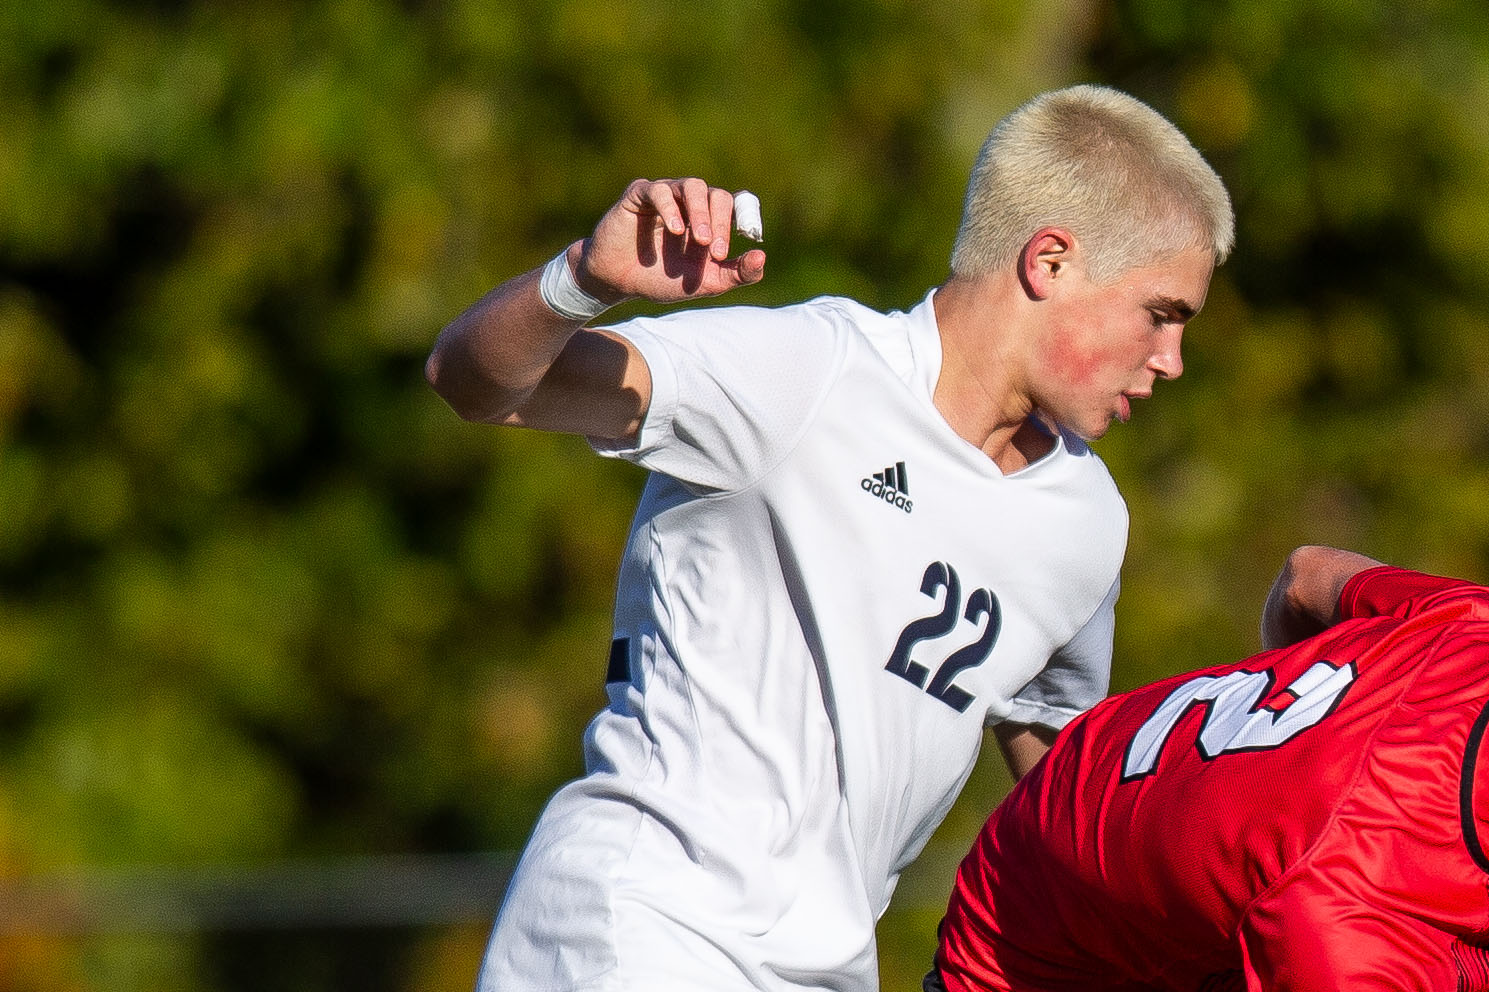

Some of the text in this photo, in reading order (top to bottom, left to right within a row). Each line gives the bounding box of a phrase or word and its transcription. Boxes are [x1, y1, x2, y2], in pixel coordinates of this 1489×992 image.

[861, 477, 913, 513] adidas
[884, 561, 1002, 714] 22
[1120, 659, 1358, 784] 2
